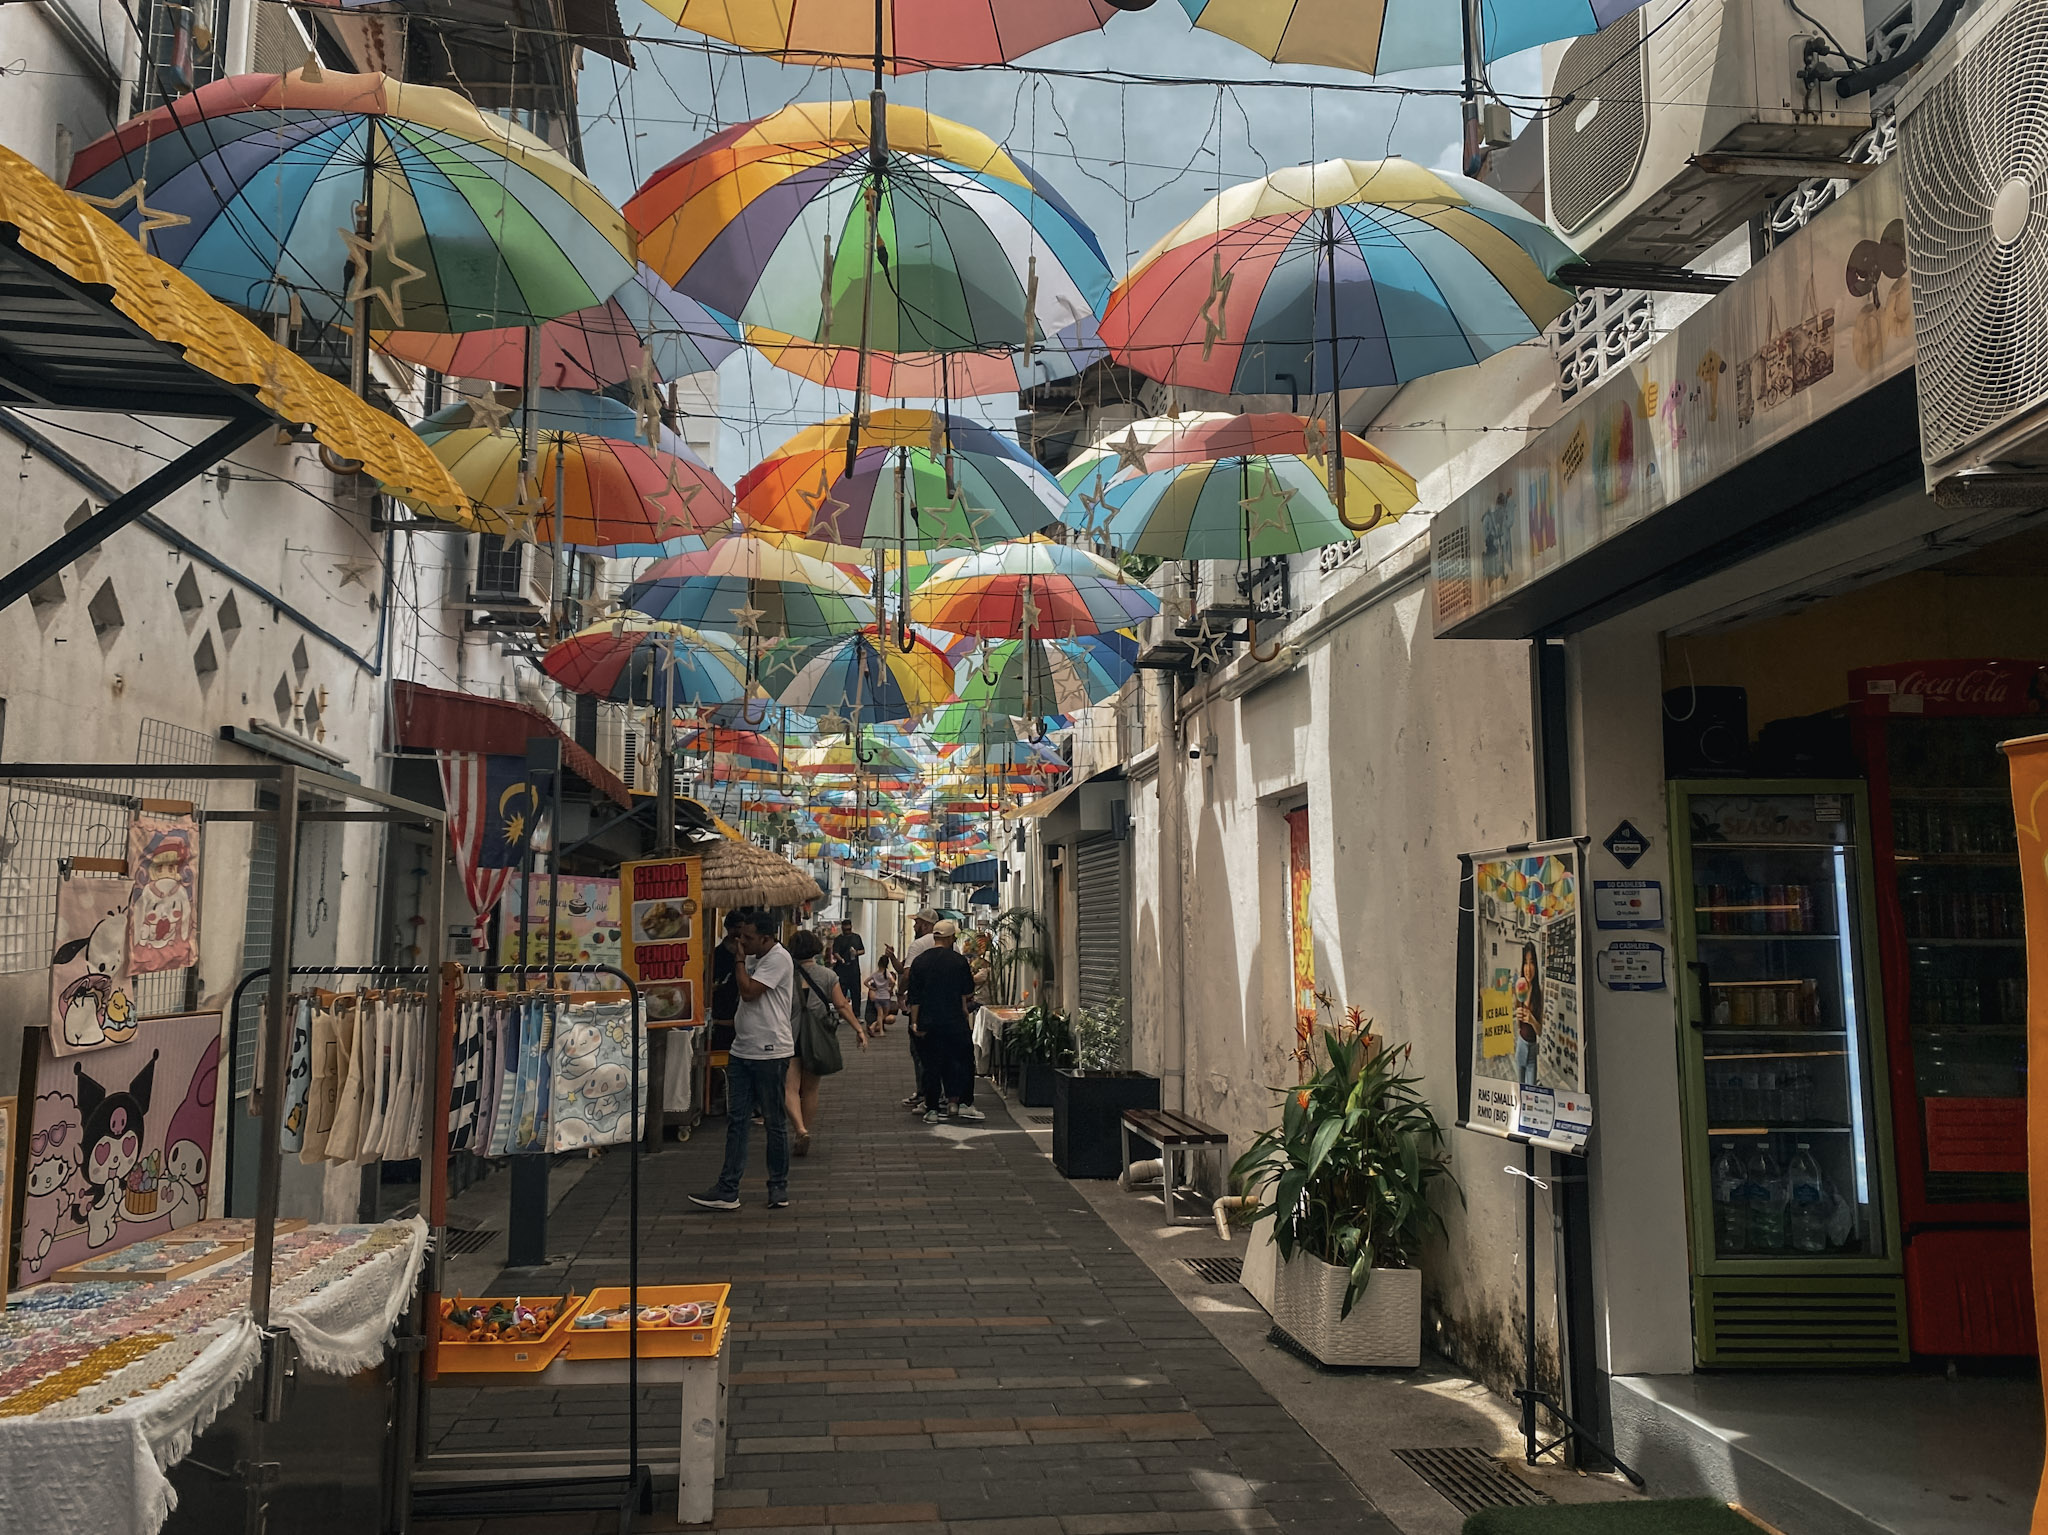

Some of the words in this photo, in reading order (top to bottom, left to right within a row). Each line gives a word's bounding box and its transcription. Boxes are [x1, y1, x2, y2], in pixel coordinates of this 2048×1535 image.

[634, 863, 688, 884] CENDOL
[634, 882, 688, 901] DURIAN
[634, 943, 690, 964] CENDOL
[639, 961, 686, 981] PULUT
[1486, 1008, 1494, 1019] ICE
[1495, 1006, 1509, 1018] BALL
[1485, 1027, 1493, 1037] AIS
[1494, 1024, 1512, 1036] KEPAL
[1478, 1088, 1490, 1102] RM5
[1490, 1091, 1518, 1110] (SMALL)
[1477, 1105, 1492, 1119] RM10
[1493, 1108, 1509, 1126] (BIG)
